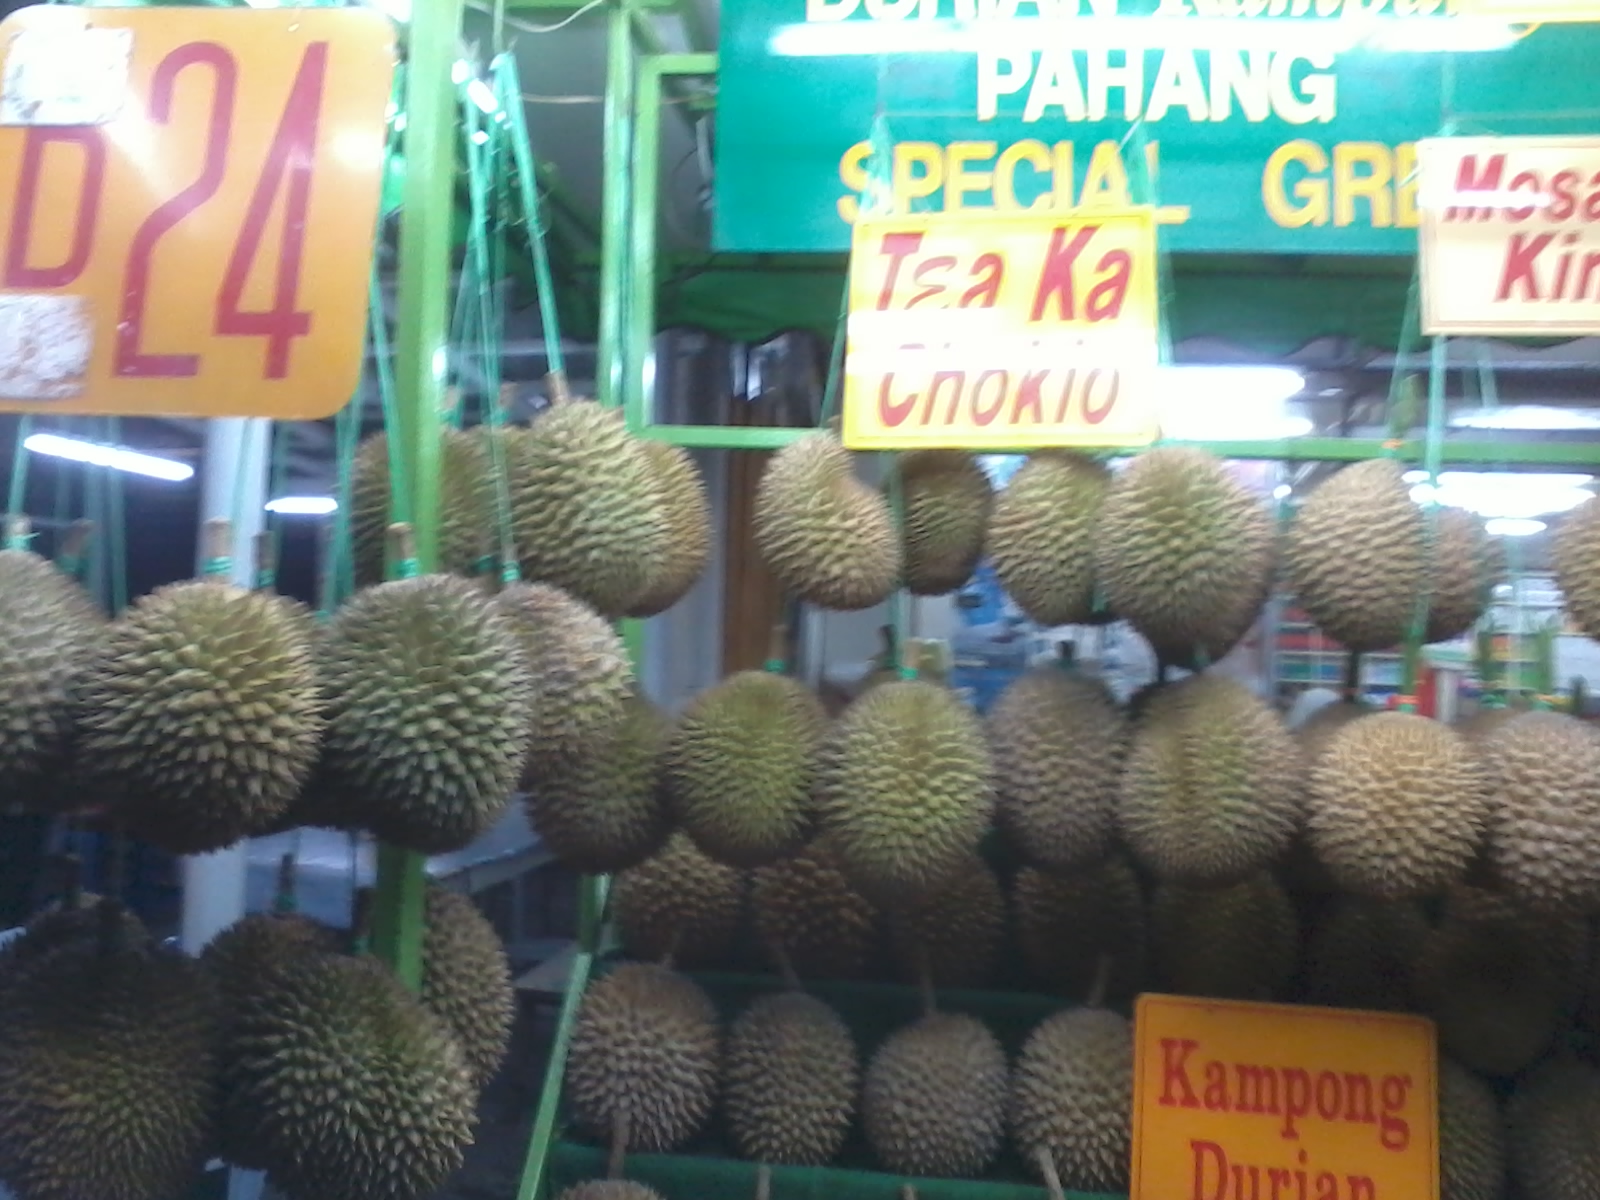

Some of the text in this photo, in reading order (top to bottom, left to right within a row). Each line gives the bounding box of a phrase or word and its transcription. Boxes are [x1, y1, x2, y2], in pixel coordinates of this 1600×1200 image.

[976, 47, 1338, 123] PAHANG
[1028, 224, 1133, 323] Ka
[1158, 1037, 1413, 1152] Kampong
